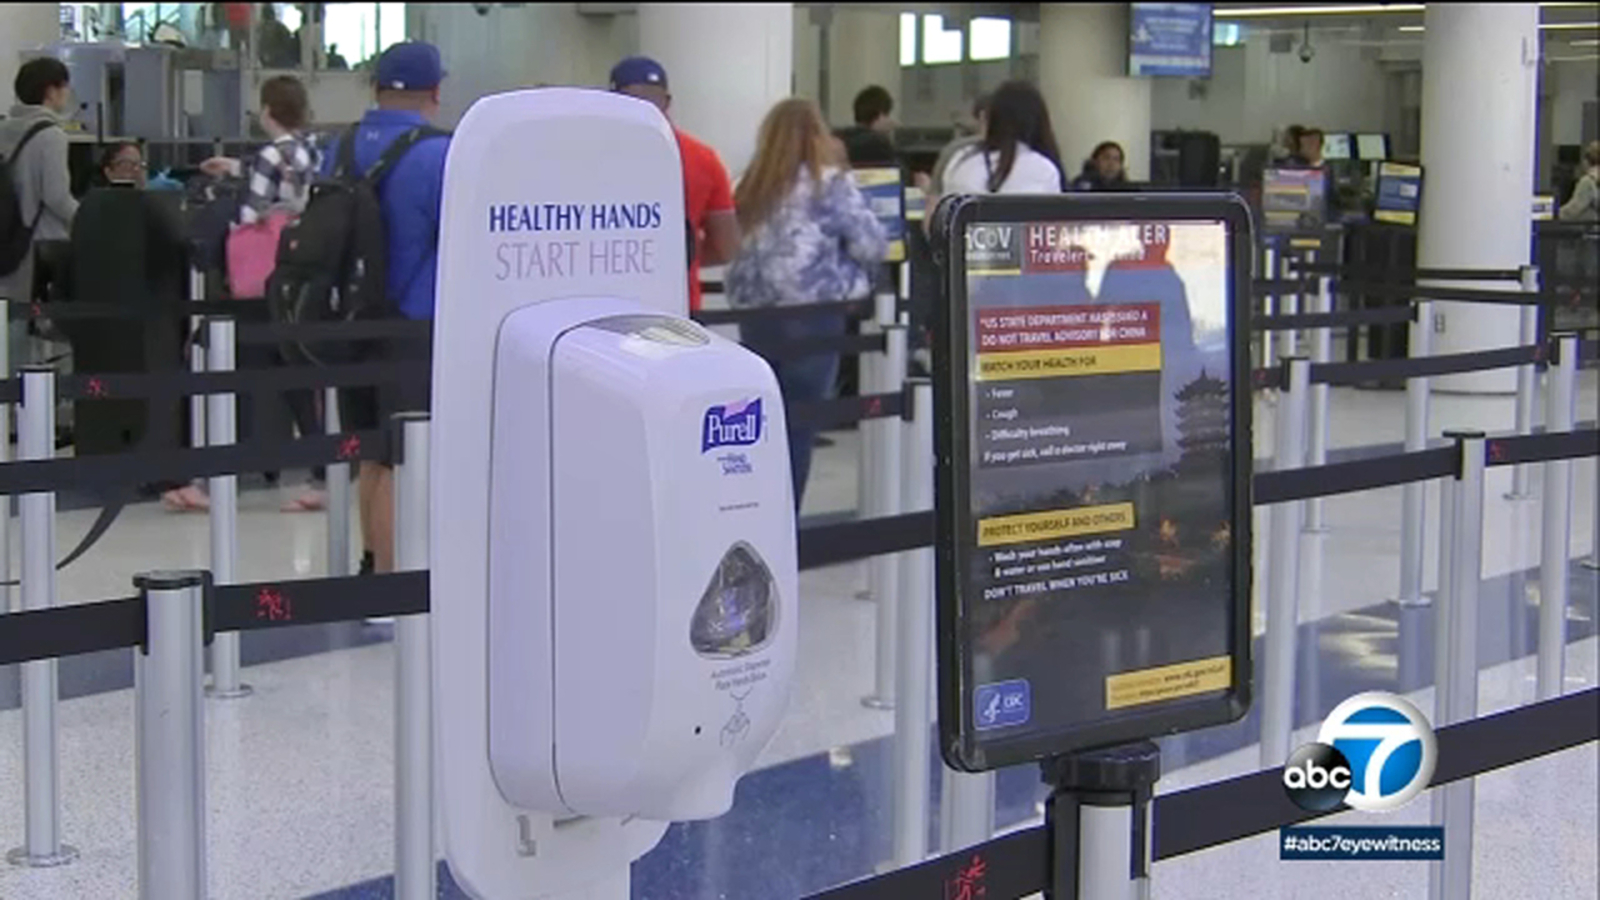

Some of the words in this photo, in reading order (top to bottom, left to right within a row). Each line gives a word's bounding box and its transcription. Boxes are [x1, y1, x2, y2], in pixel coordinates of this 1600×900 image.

[489, 203, 585, 232] HEALTHY
[591, 202, 661, 230] HANDS
[495, 241, 580, 281] START
[589, 239, 655, 276] HERE
[1000, 315, 1026, 328] STATE
[1028, 312, 1087, 327] DEPARTMENT
[981, 333, 997, 346] DO
[998, 331, 1018, 345] NOT
[1019, 330, 1053, 344] TRAVEL
[1054, 328, 1098, 342] ADVISORY
[1119, 325, 1146, 339] CHINA
[991, 407, 1018, 421] Cough
[707, 413, 757, 444] Purell
[982, 523, 1023, 538] PROTECT
[1024, 517, 1070, 534] YOURSELF
[1071, 514, 1091, 528] AND
[1014, 582, 1049, 597] TRAVEL
[1049, 577, 1076, 592] WHEN
[1109, 569, 1130, 583] SICK
